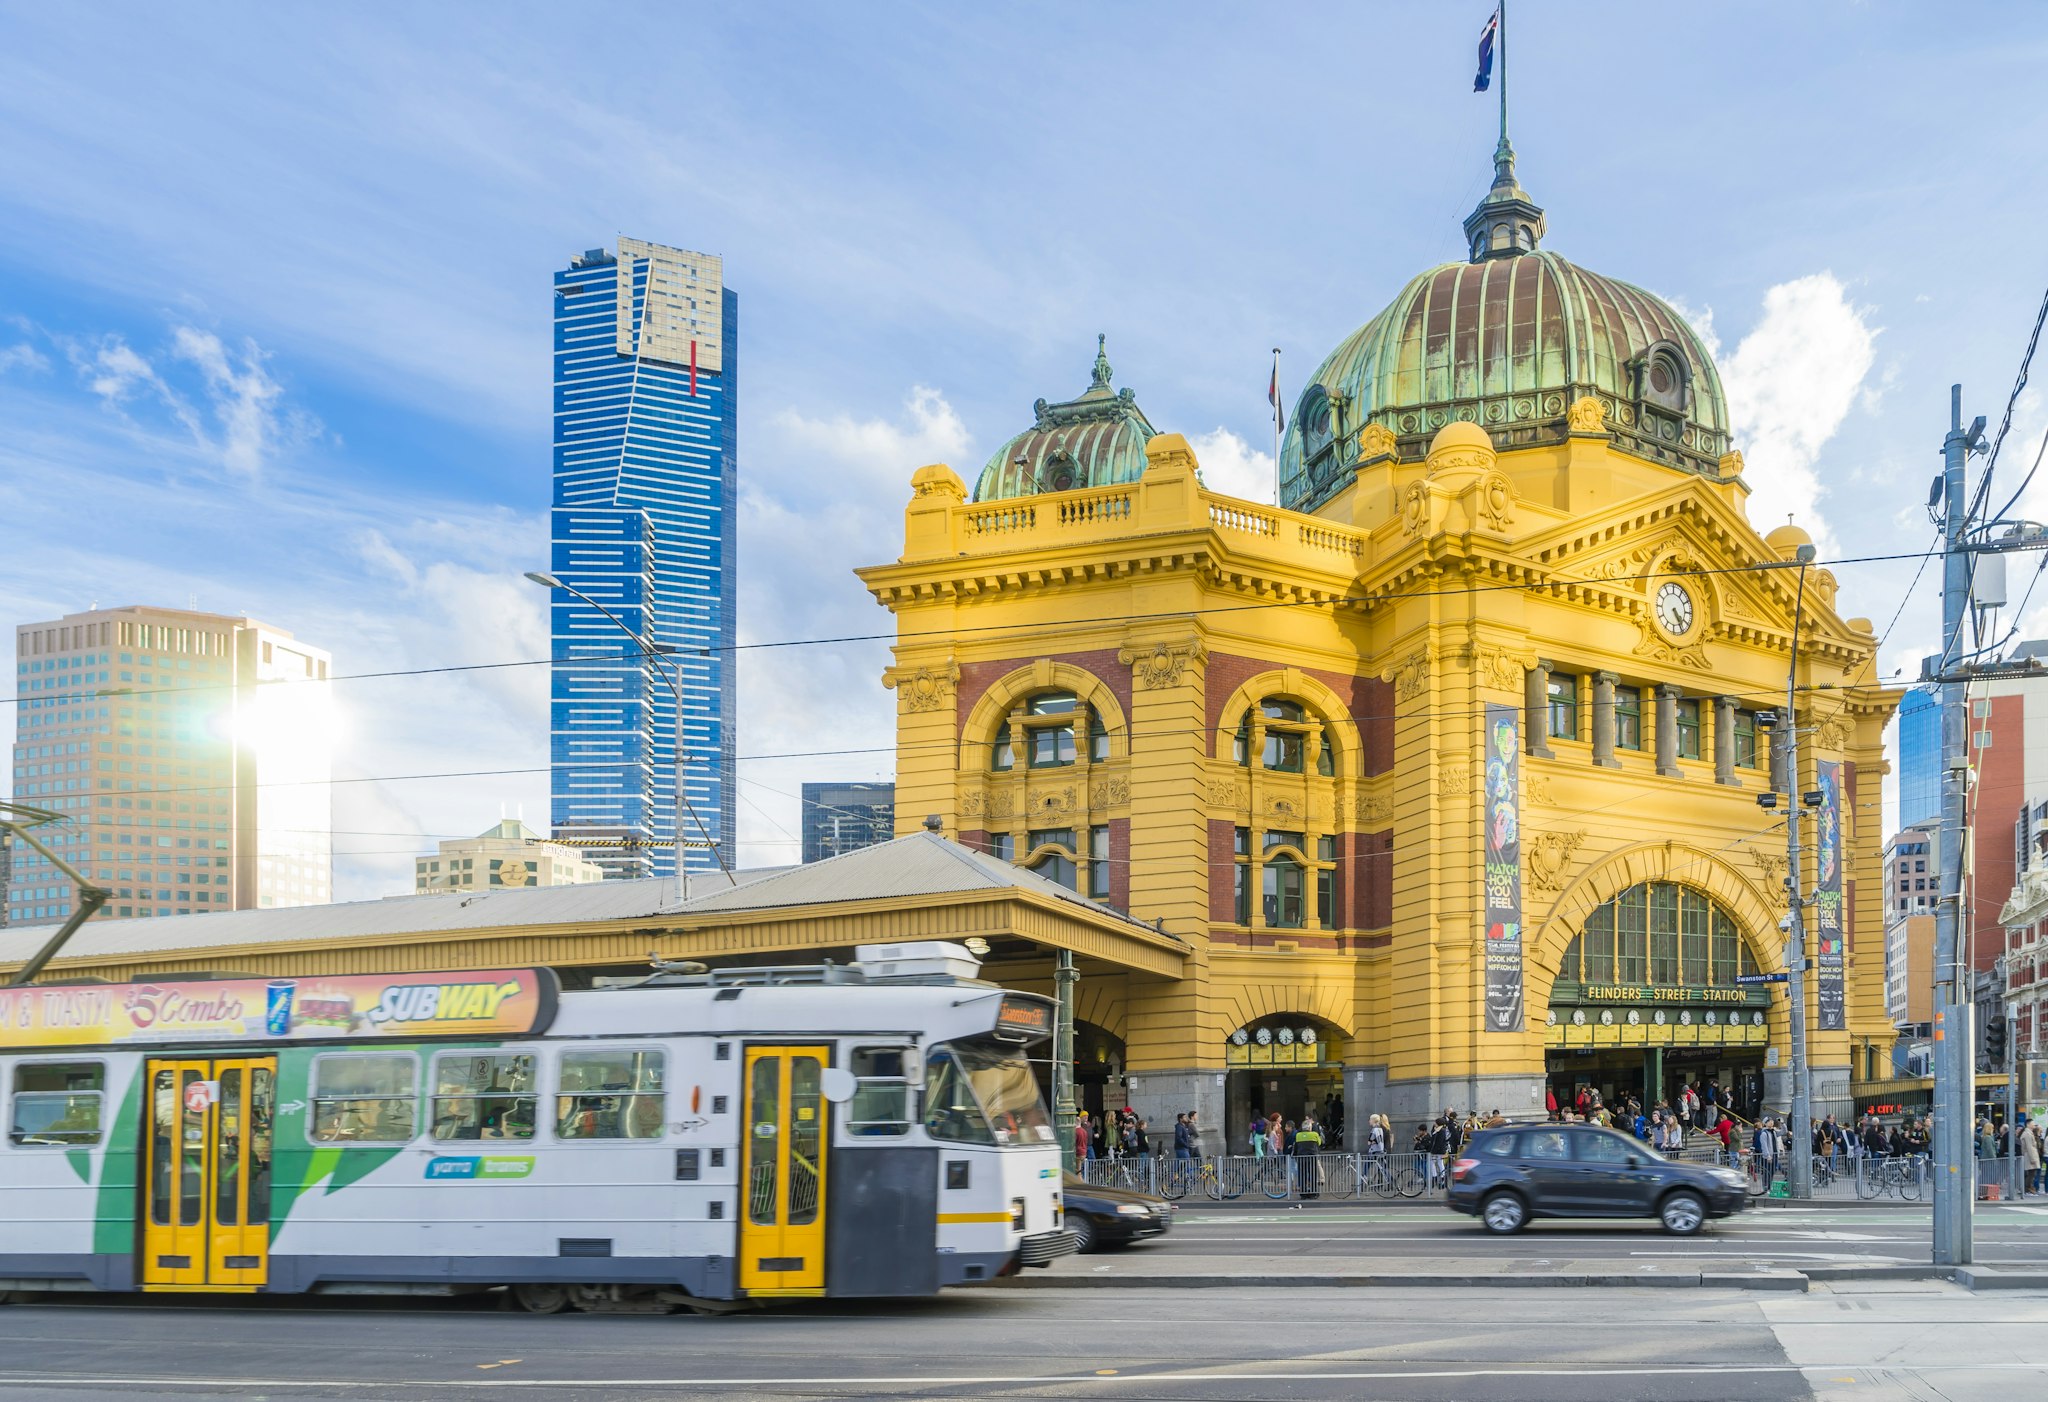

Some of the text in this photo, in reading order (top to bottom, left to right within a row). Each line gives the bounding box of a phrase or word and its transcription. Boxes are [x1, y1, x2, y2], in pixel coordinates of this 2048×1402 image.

[1487, 862, 1518, 876] WATCH
[1489, 874, 1512, 886] HOW
[1487, 885, 1510, 897] YOU
[1819, 891, 1841, 901] WATCH
[1490, 896, 1514, 909] FEEL
[1820, 900, 1837, 910] HOW
[1820, 909, 1836, 919] YOU
[1821, 918, 1838, 929] FEEL
[1487, 955, 1521, 963] BOOK NOW
[1588, 986, 1747, 1002] FLINDERS STREET STATION
[160, 989, 244, 1023] Combo
[368, 978, 522, 1026] SUBWAY
[18, 993, 33, 1029] &
